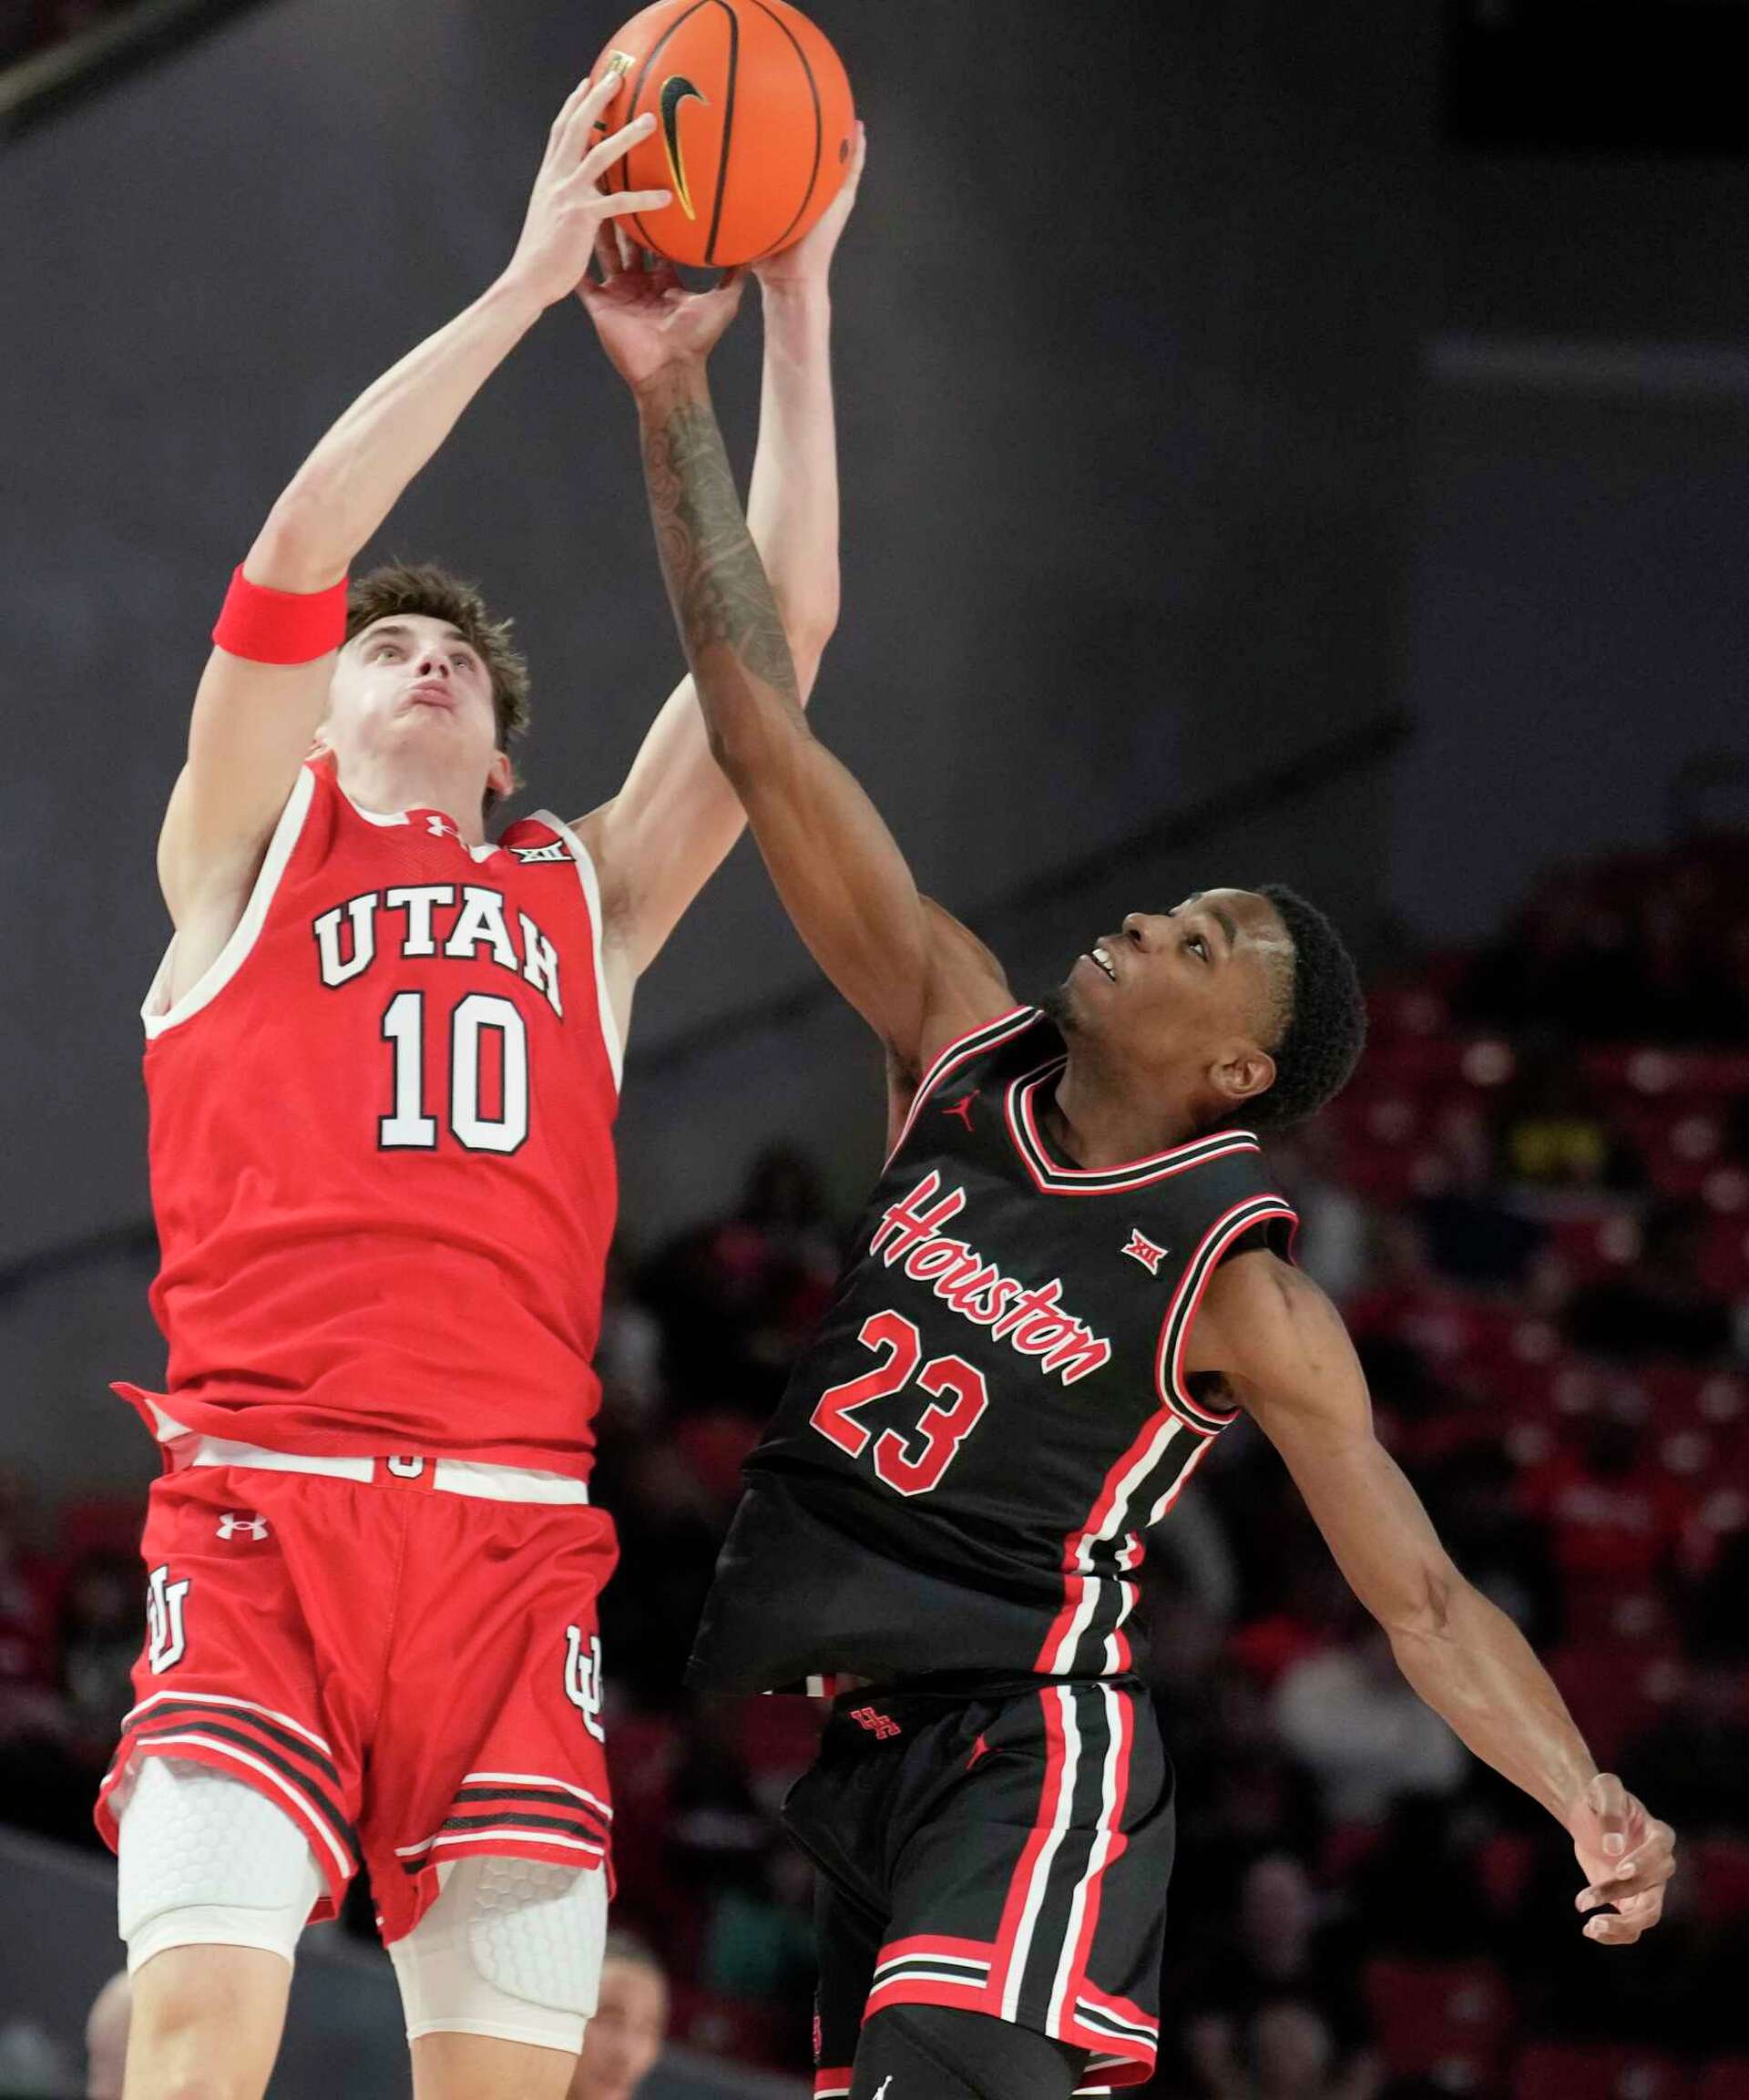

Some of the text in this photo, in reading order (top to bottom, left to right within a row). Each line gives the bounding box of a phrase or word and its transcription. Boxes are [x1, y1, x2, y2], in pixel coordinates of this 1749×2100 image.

[313, 883, 564, 1024] UTAH
[378, 990, 529, 1156] 10
[869, 1169, 1111, 1386] Houston
[809, 1308, 989, 1497] 23
